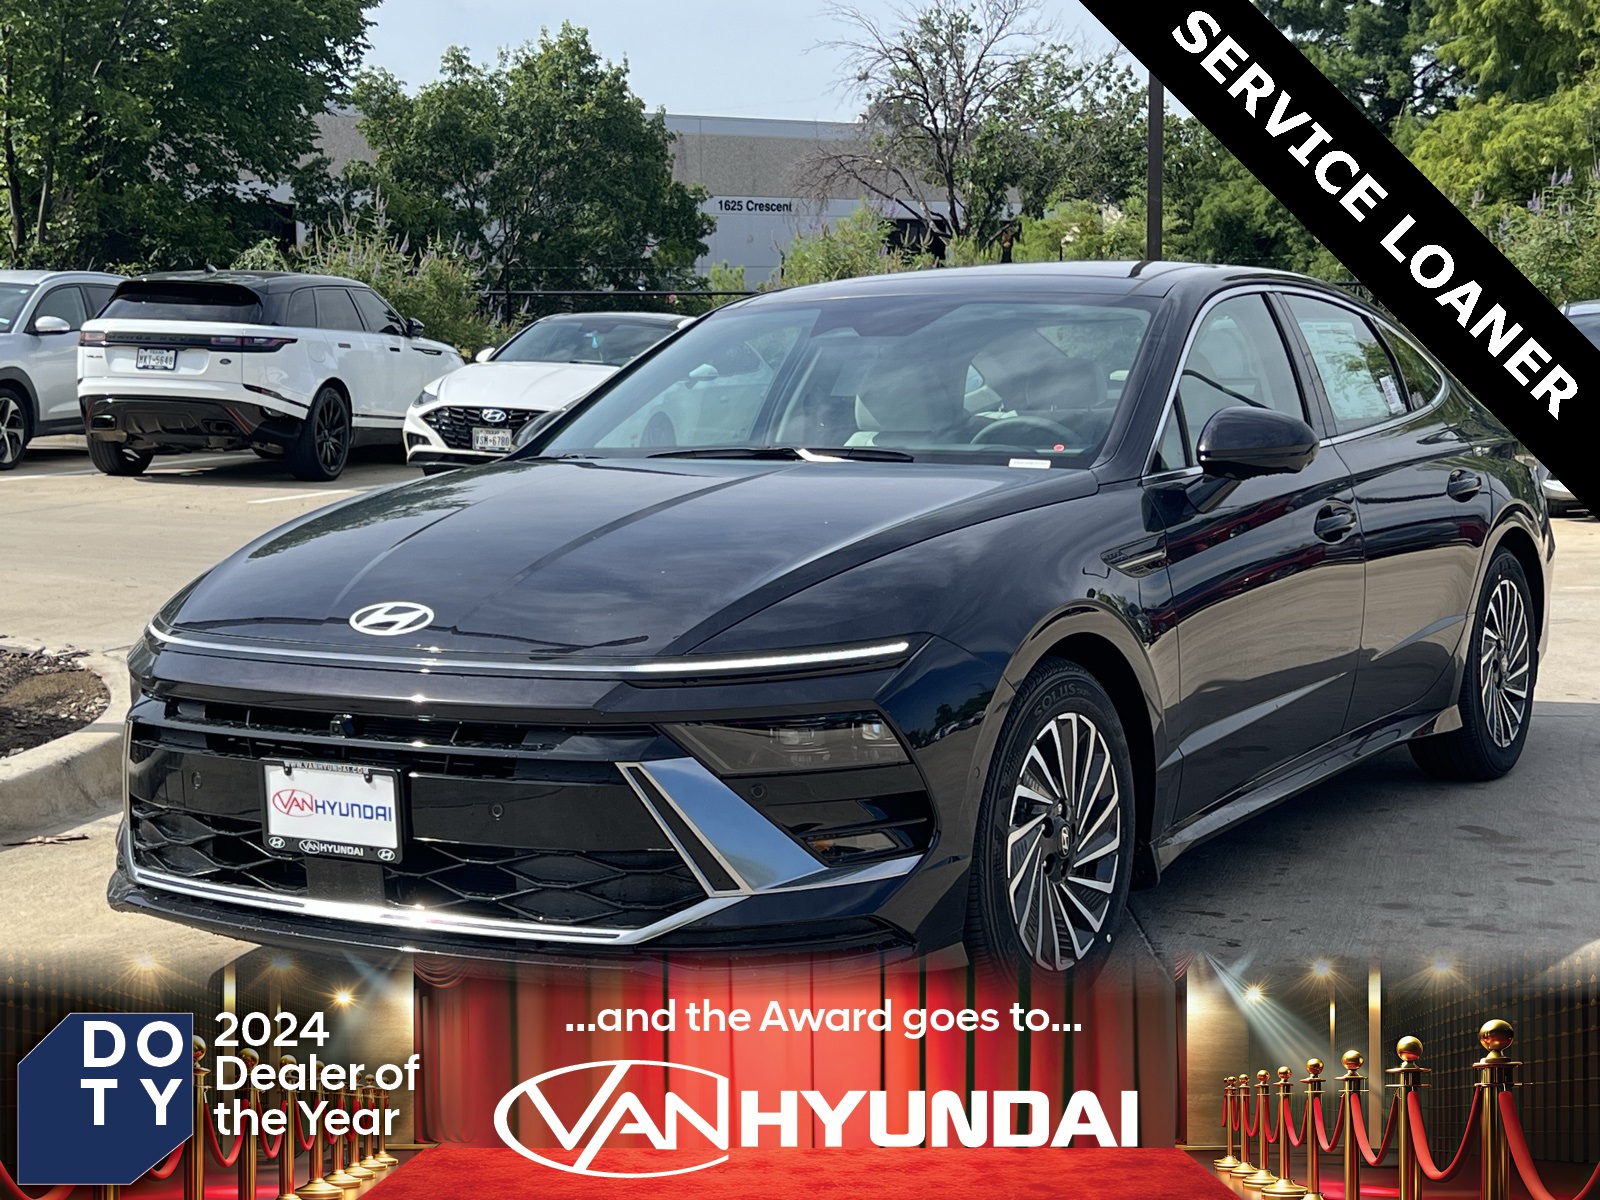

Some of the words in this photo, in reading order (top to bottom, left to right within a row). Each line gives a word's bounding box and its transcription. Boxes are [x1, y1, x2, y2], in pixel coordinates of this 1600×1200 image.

[718, 200, 743, 211] 1625
[746, 200, 792, 212] Crescent
[1036, 683, 1077, 718] SOLUS
